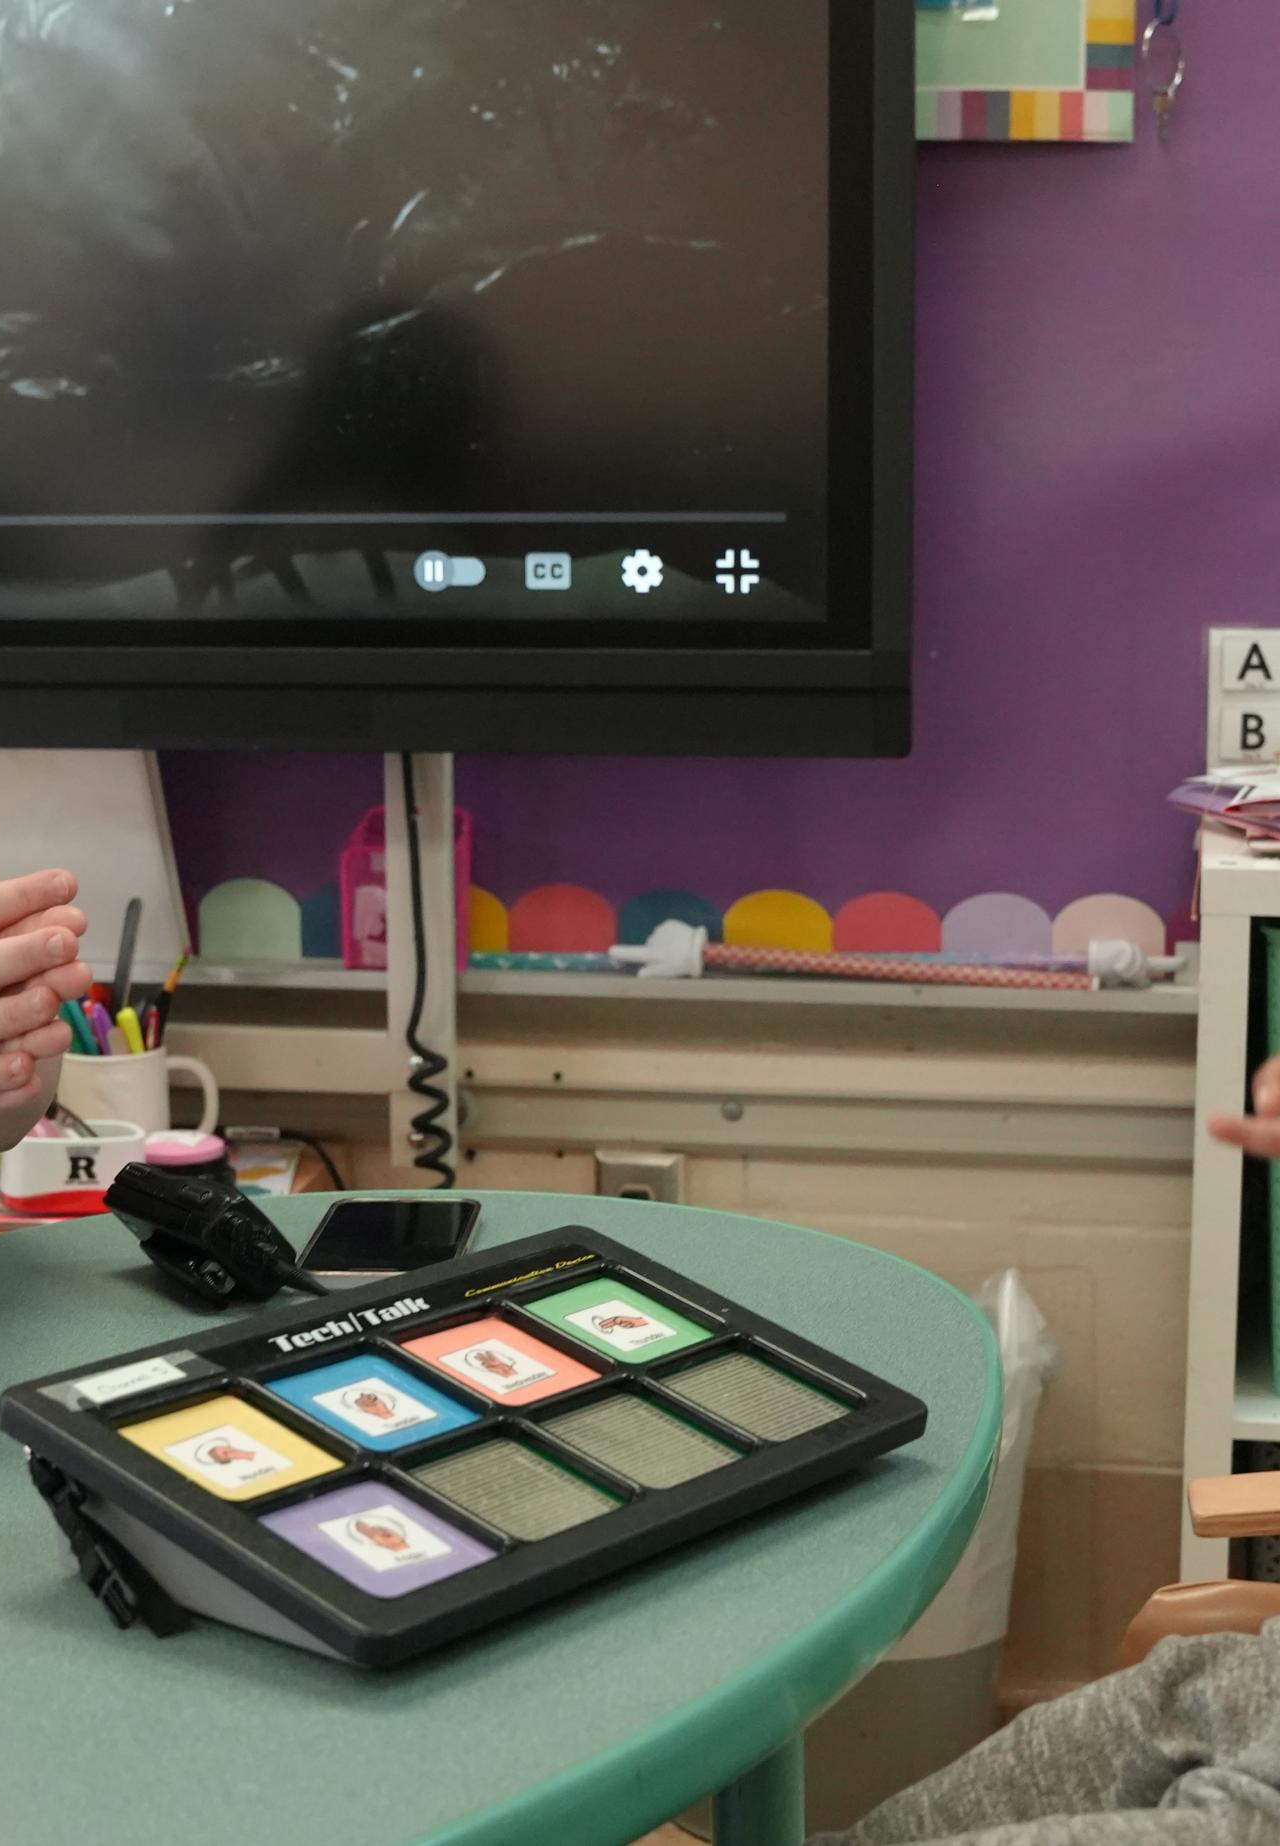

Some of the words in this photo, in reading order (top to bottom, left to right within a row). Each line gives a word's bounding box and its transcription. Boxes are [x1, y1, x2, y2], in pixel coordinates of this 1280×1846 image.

[533, 562, 564, 580] CC
[1237, 642, 1273, 681] A
[1240, 712, 1266, 751] B
[68, 1155, 97, 1180] R
[267, 1296, 432, 1353] Tech/Talk
